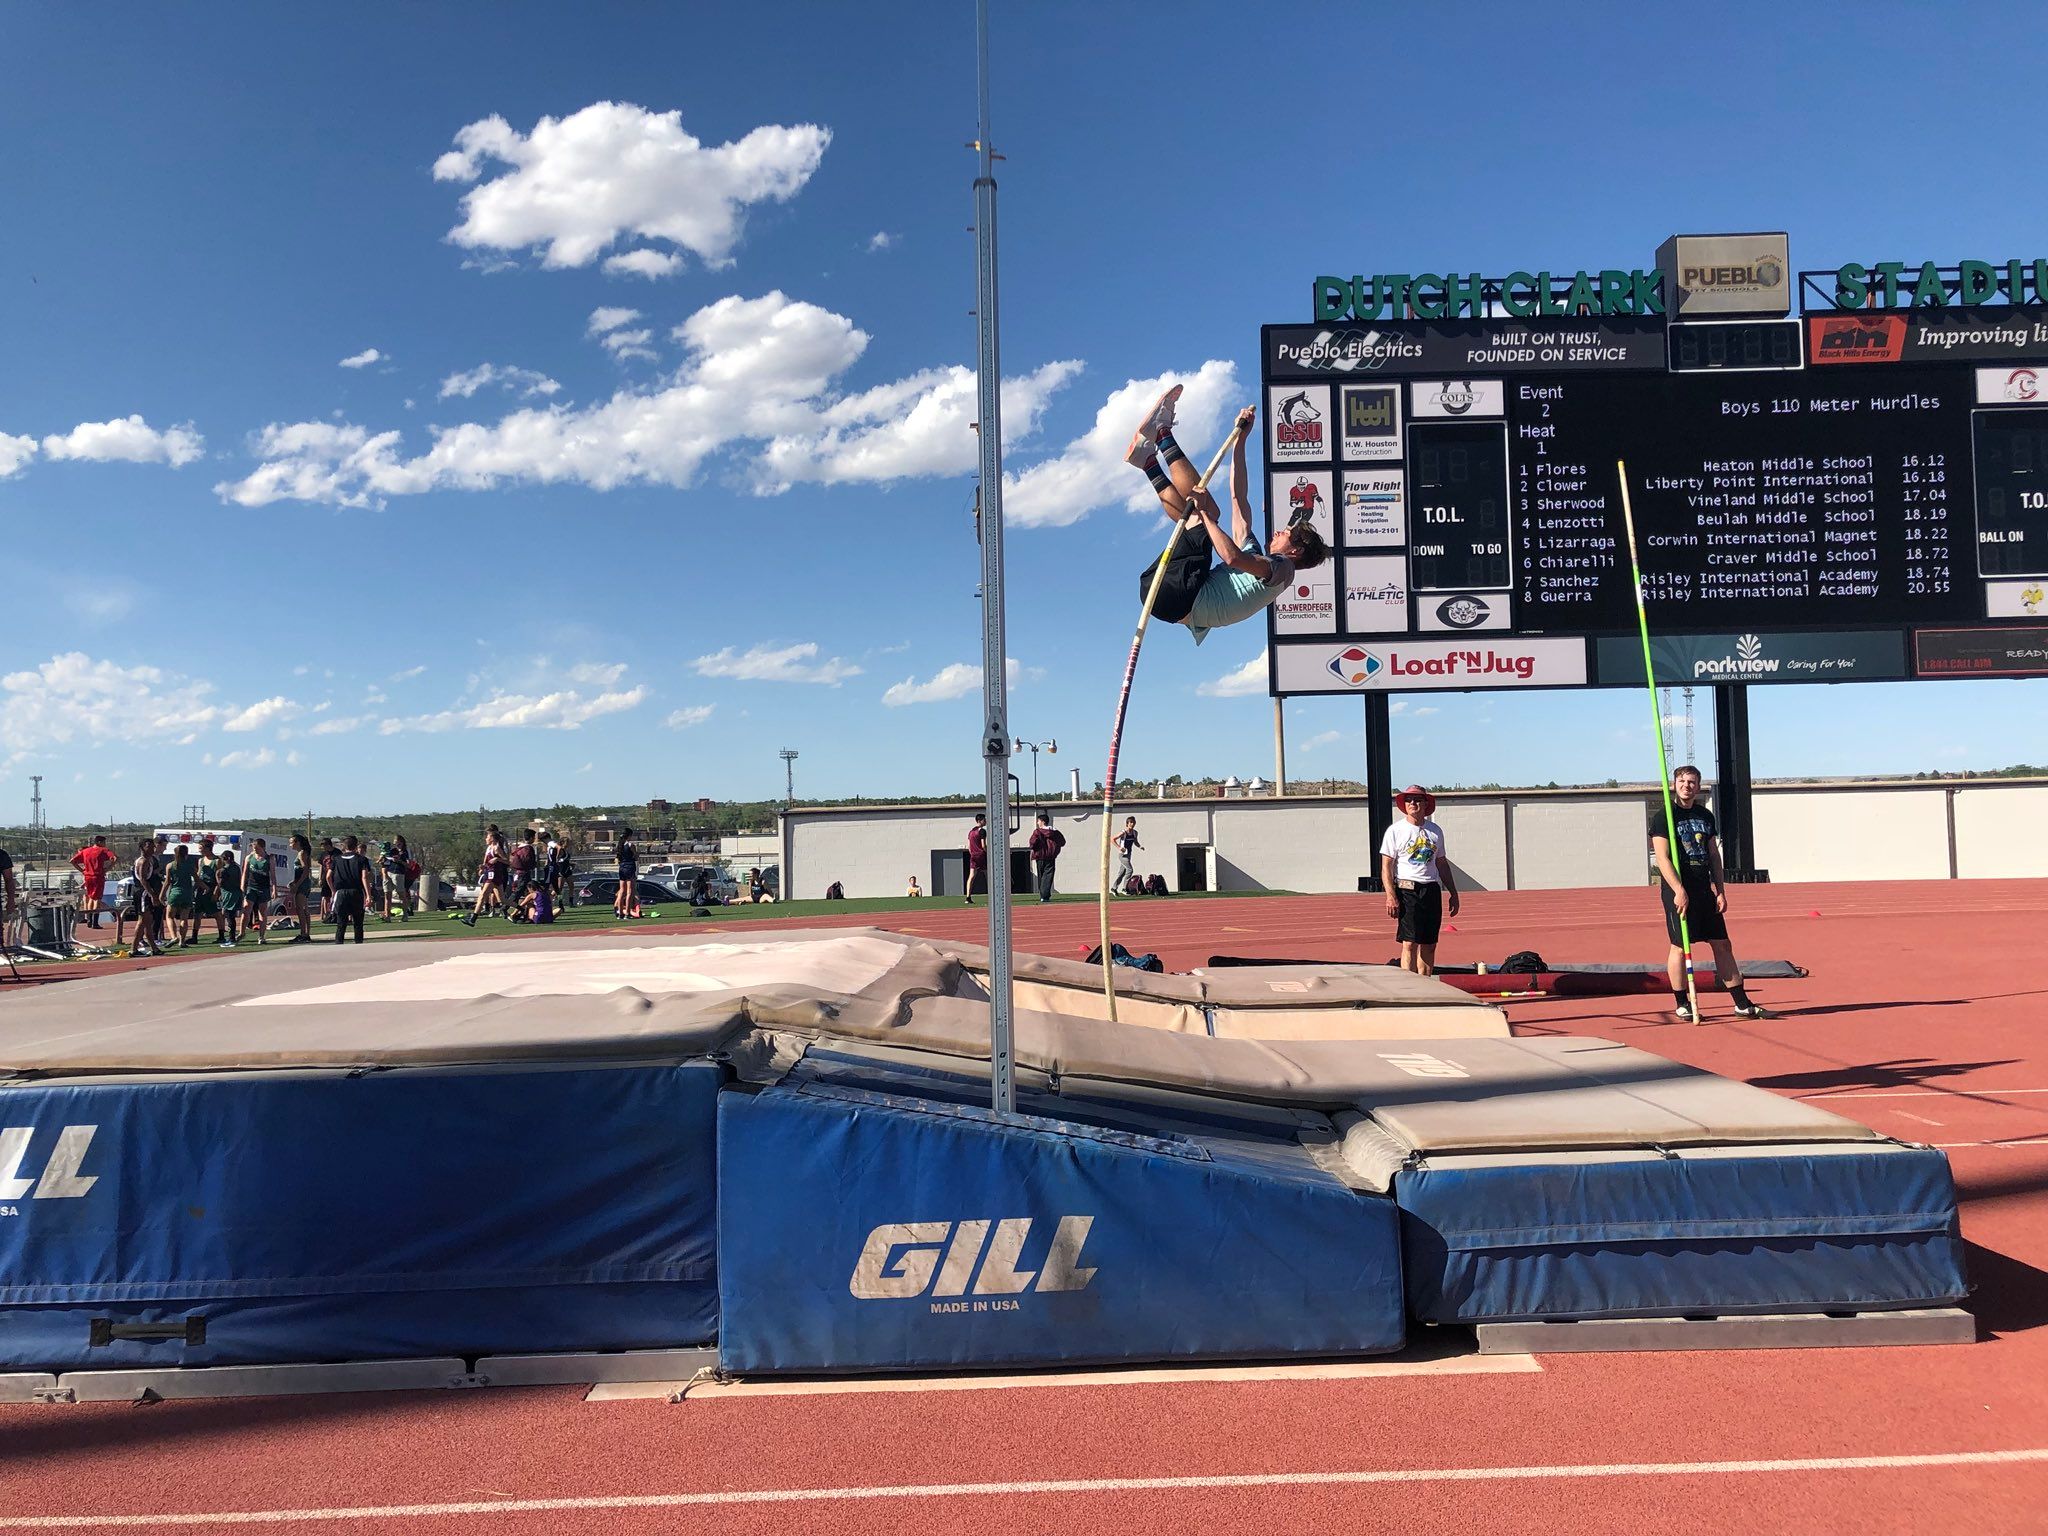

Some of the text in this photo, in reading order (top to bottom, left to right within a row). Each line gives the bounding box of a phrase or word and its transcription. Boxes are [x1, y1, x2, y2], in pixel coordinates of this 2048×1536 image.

[1314, 272, 1481, 321] DUTCH
[1502, 270, 1666, 317] CLARK
[1492, 332, 1601, 346] BUILT ON TRUST,
[1918, 326, 2028, 349] Improving
[1278, 341, 1423, 360] Pueblo Electrics
[1467, 347, 1627, 363] FOUNDED ON SERVICE
[1819, 350, 1842, 358] Black
[1862, 349, 1891, 358] Energy
[1440, 393, 1474, 402] COLTS
[1520, 385, 1564, 399] Event
[1541, 404, 1550, 417] 2
[1721, 395, 1940, 417] Boys 110 Meter Hurdles
[1280, 423, 1321, 442] CSU
[1520, 424, 1556, 438] Heat
[1366, 440, 1398, 448] Houston
[1537, 441, 1547, 455] 1
[1277, 449, 1324, 457] csupueblo.edu
[1520, 455, 1945, 476] 1 Flores Heaton Middle School 16.12
[1344, 481, 1401, 491] Flow Right
[1520, 471, 1945, 492] 2 Clower Liberty Point International 16.18
[1521, 489, 1947, 510] 3 Sherwood Vineland Middle School 17.04
[2020, 492, 2048, 508] T.O.
[1423, 507, 1465, 523] T.O.L.
[1522, 508, 1947, 529] 4 Lenzotti Beulah Middle School 18.19
[1523, 528, 1948, 550] 5 Lizarraga Corwin International Magnet 18.22
[1979, 530, 2024, 543] BALL ON
[1413, 543, 1502, 556] DOWN TO GO
[1523, 547, 1949, 568] 6 Chiarelli Craver Middle School 18.72
[1524, 566, 1950, 588] 7 Sanchez Risley International Academy 18.74
[1346, 591, 1404, 601] ATHLETIC
[1524, 581, 1950, 602] 8 Guerra Risley International Academy 20.55
[1694, 656, 1780, 678] parkview
[1787, 659, 1817, 672] Caring
[1820, 659, 1835, 668] For
[849, 1215, 1099, 1300] GILL
[931, 1300, 1020, 1314] MADE IN USA
